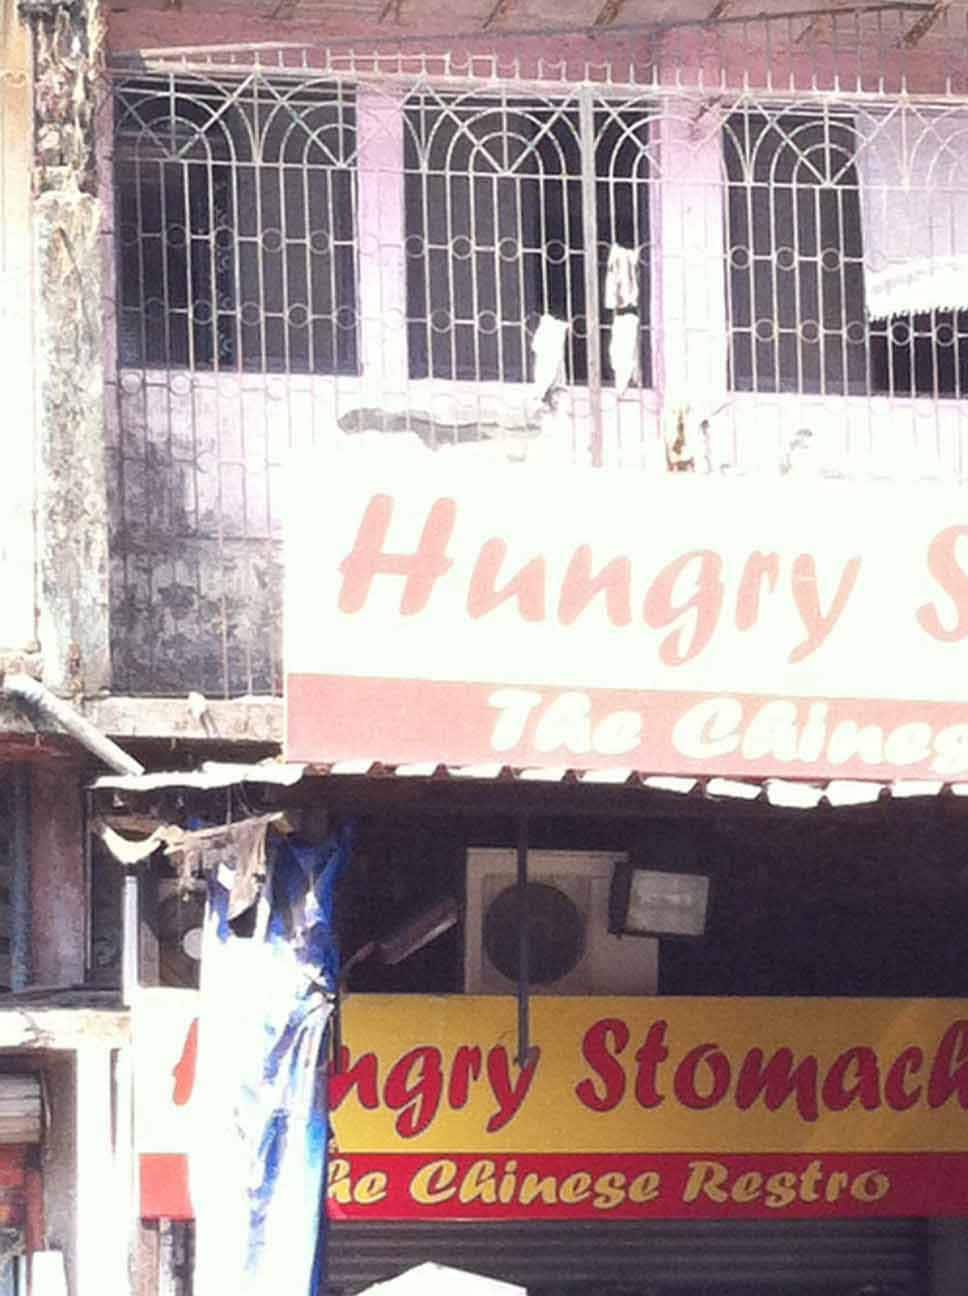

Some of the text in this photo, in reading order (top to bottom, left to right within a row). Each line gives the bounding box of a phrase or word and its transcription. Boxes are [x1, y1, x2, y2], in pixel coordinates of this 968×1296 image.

[337, 492, 862, 667] Hungry
[487, 687, 644, 755] The
[327, 1044, 541, 1139] ngry
[327, 1159, 891, 1209] he Chinese Restro
